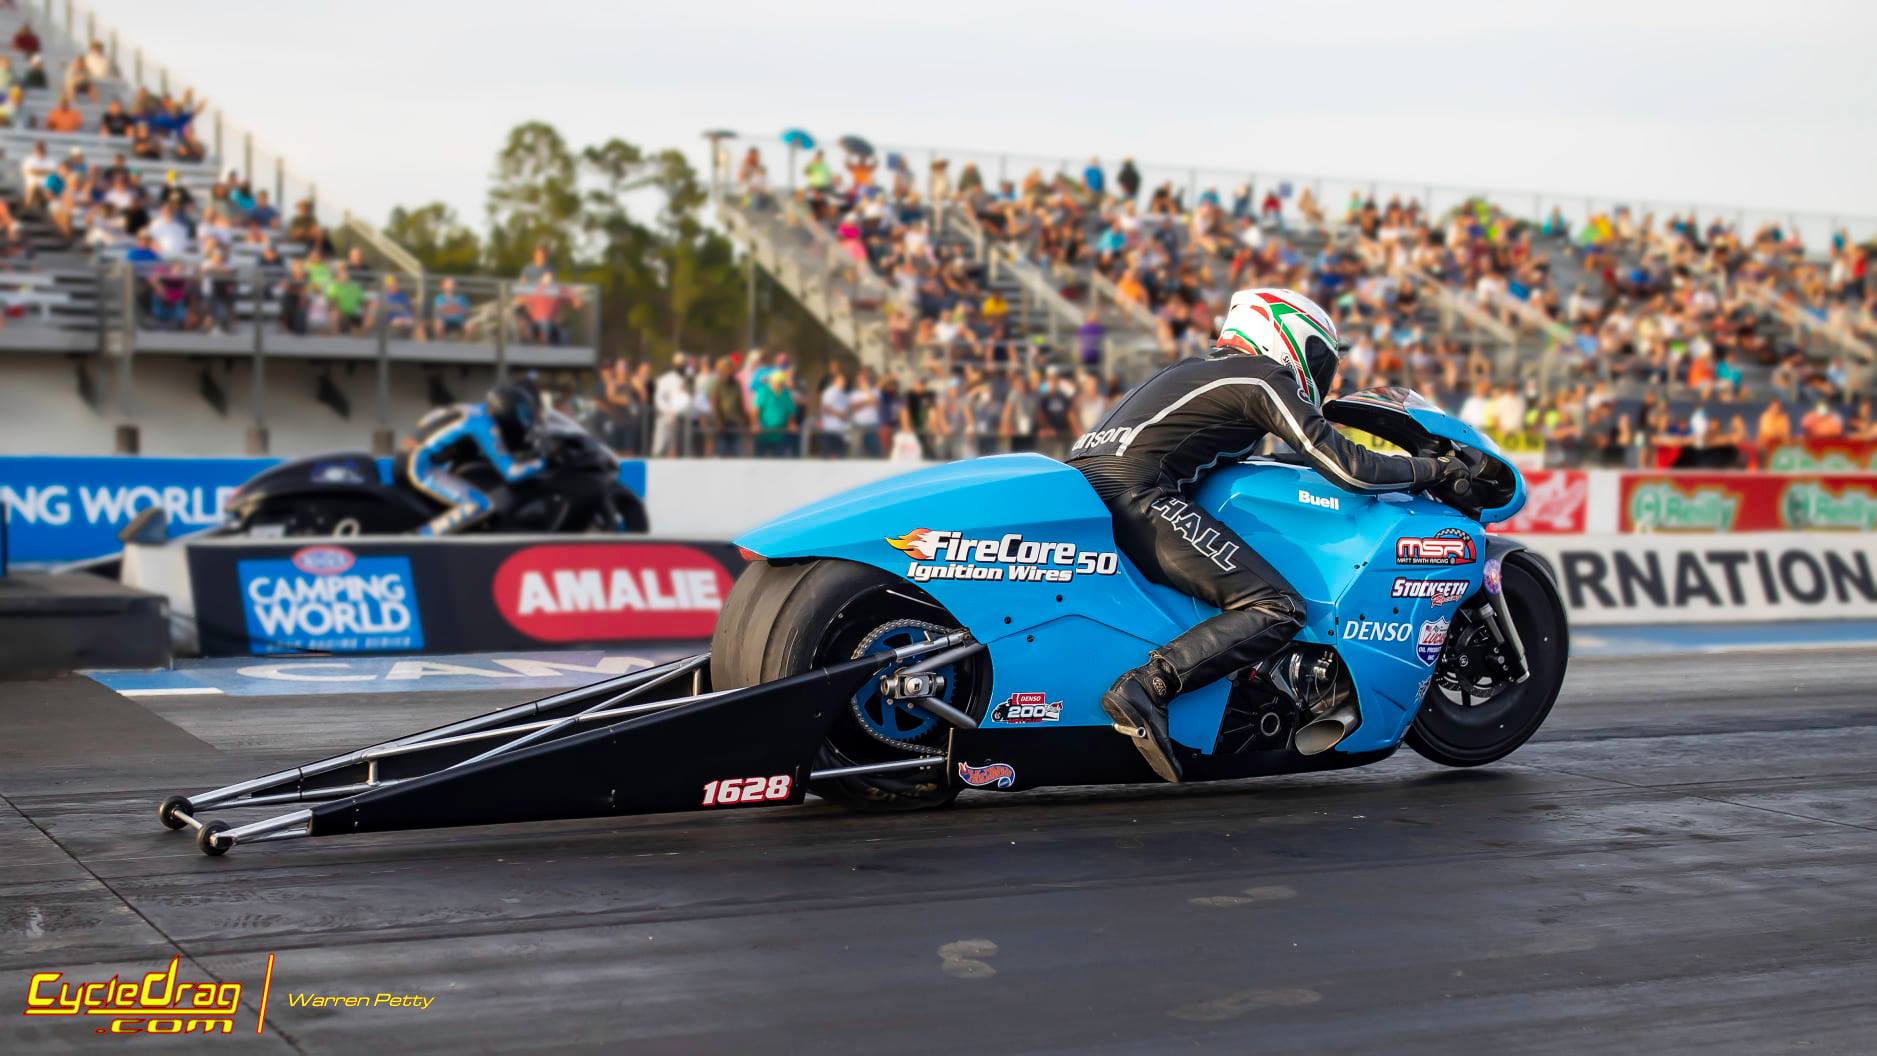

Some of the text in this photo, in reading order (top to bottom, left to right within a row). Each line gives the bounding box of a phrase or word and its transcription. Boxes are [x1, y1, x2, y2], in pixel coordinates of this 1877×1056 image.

[1298, 489, 1339, 510] Buell
[1151, 497, 1239, 571] HALL
[1396, 537, 1465, 558] MSR
[928, 530, 1118, 575] FireCore 50
[907, 562, 1073, 582] Ignition Wires
[1560, 549, 1877, 609] RNATION
[248, 573, 406, 604] CAMPING
[517, 568, 723, 615] AMALIE
[254, 602, 411, 636] WORLD
[1343, 620, 1413, 642] DENSO
[1007, 705, 1045, 718] 200
[702, 775, 792, 806] 1628
